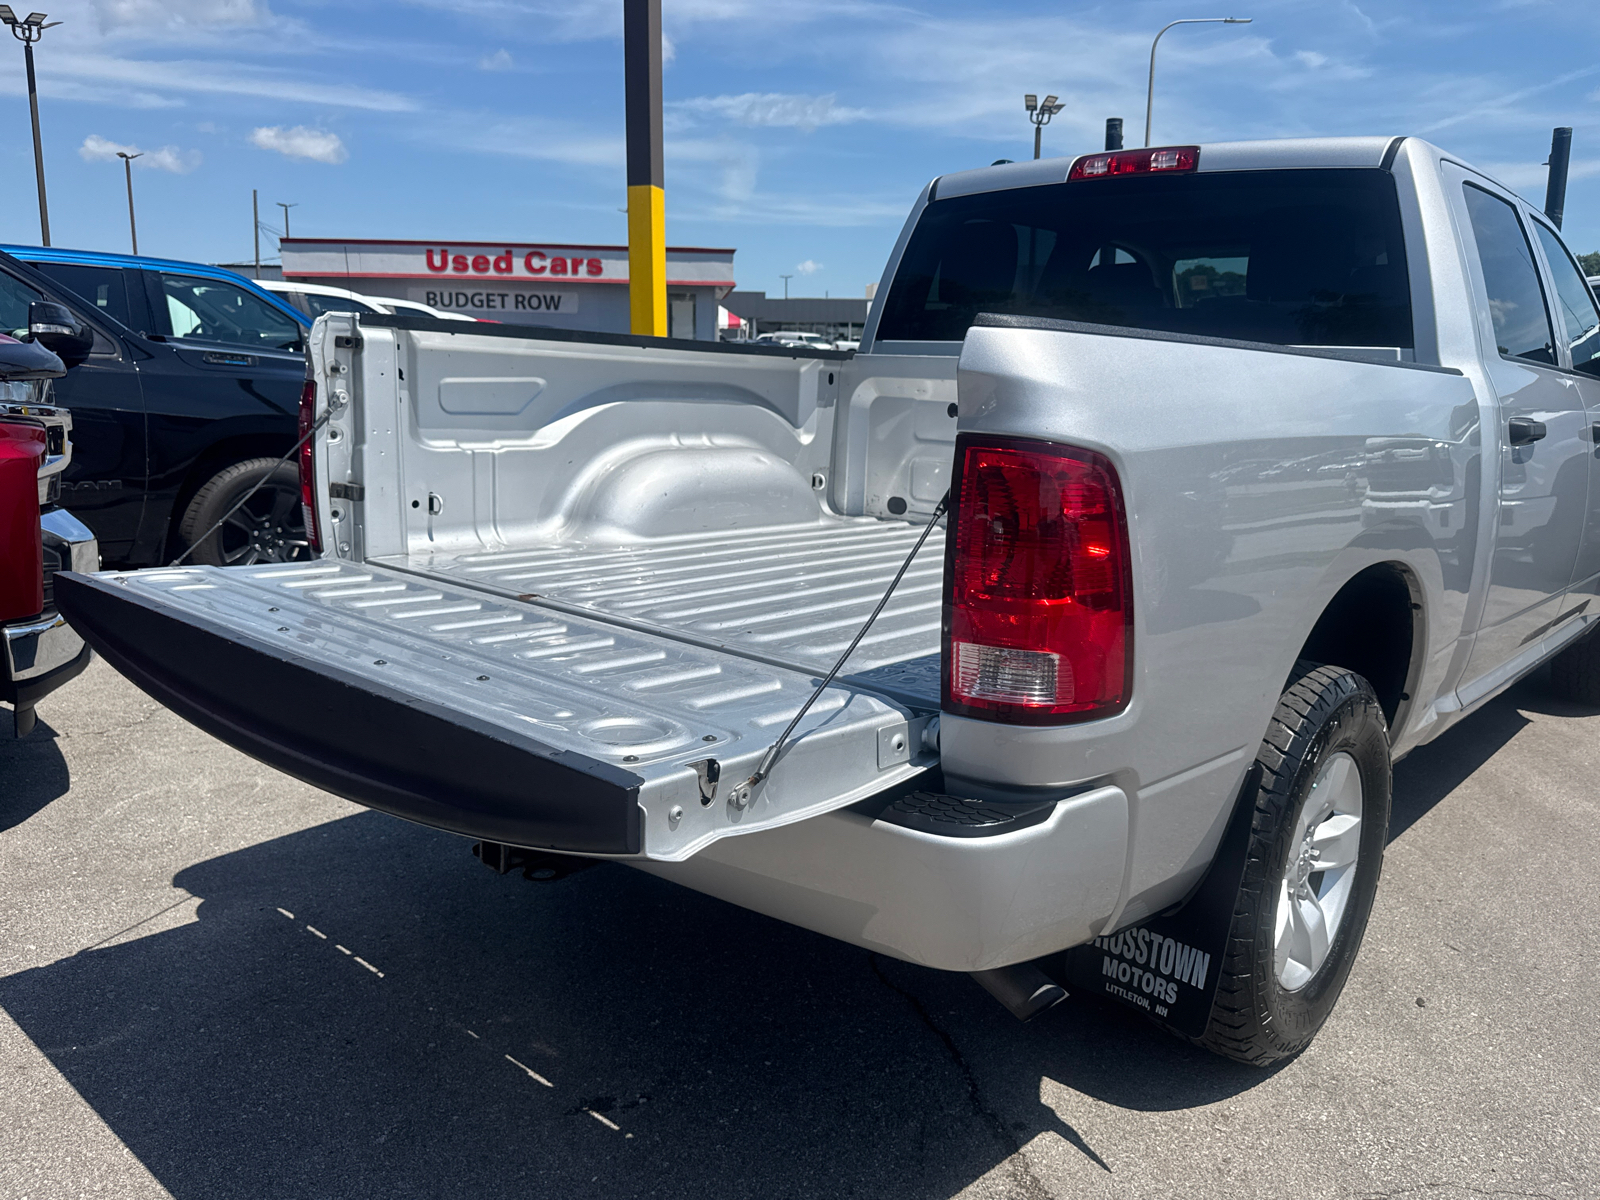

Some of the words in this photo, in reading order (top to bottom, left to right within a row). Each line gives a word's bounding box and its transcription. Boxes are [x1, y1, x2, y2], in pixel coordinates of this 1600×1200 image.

[425, 249, 514, 274] Used
[524, 251, 604, 276] Cars
[426, 291, 509, 309] BUDGET
[514, 294, 562, 311] ROW
[61, 479, 123, 491] RAM
[1087, 927, 1211, 990] OSSTOWN
[1102, 955, 1178, 1004] MOTORS
[1105, 982, 1150, 1010] LITTLETON,
[1155, 1004, 1168, 1017] NH
